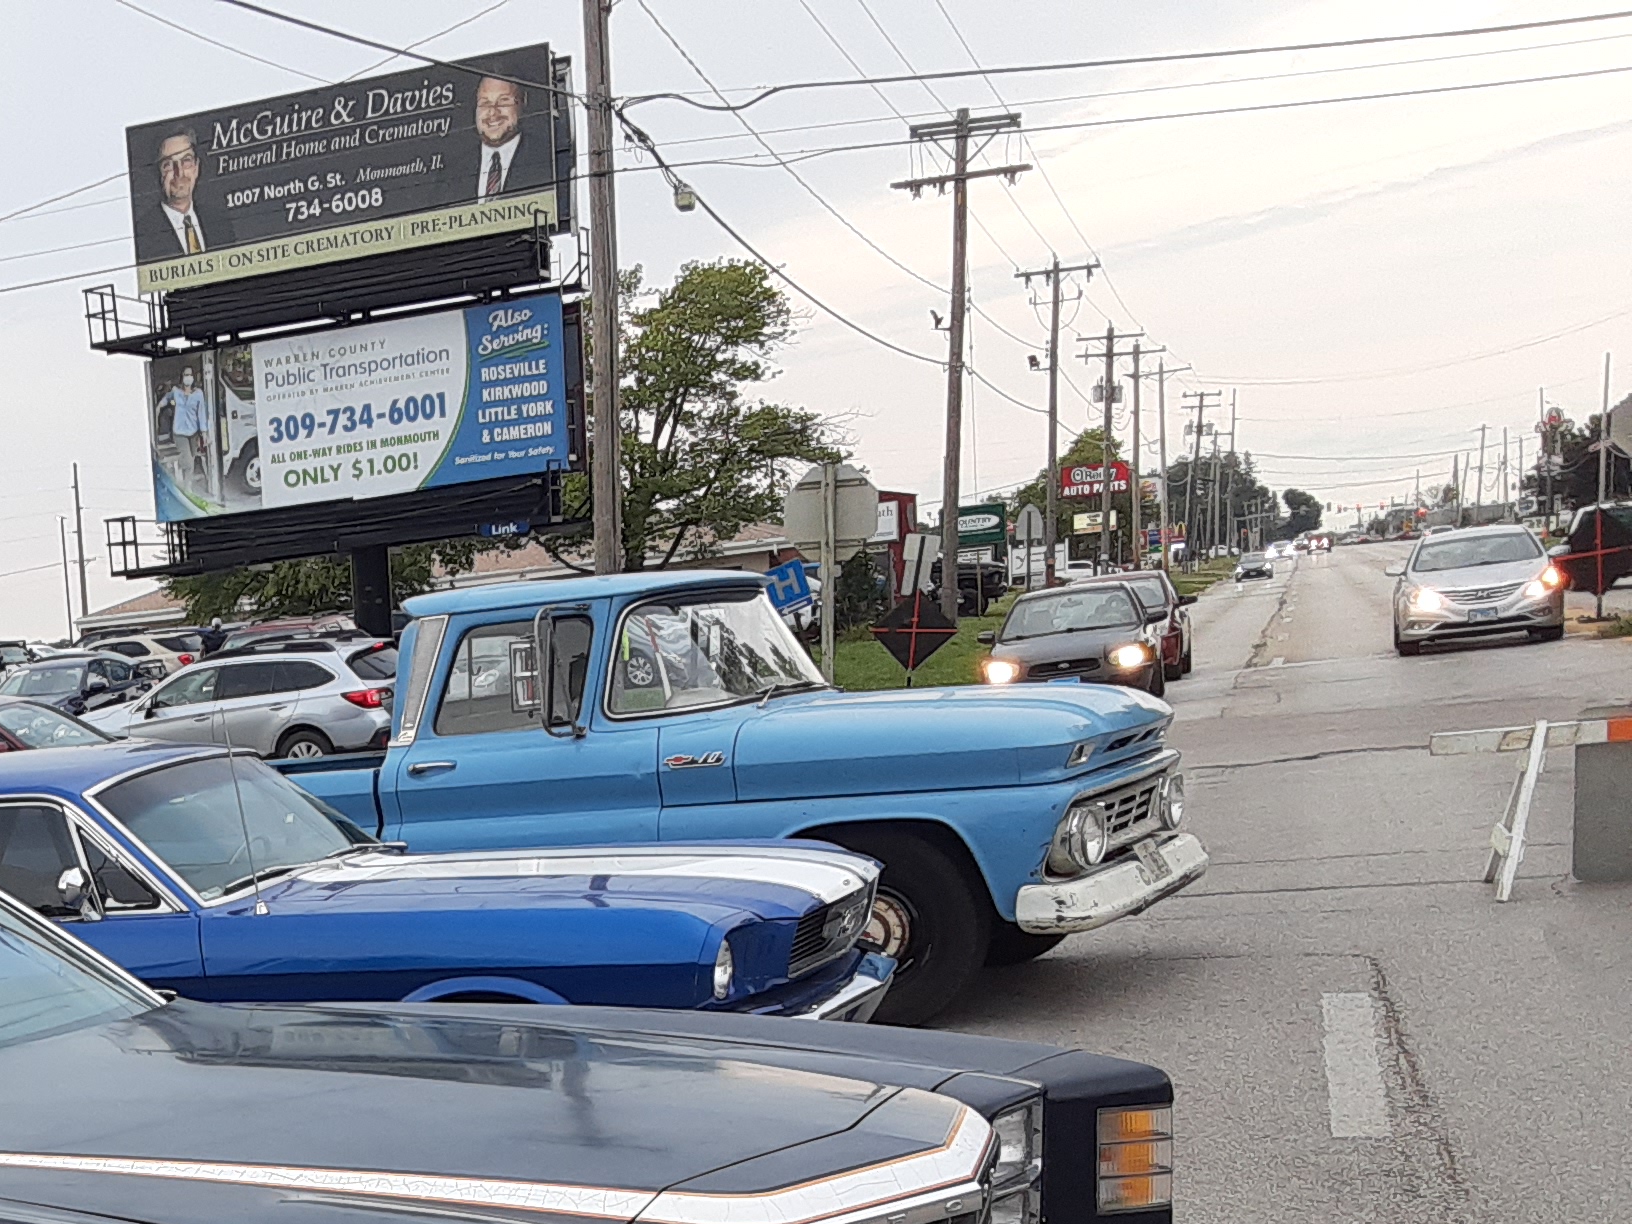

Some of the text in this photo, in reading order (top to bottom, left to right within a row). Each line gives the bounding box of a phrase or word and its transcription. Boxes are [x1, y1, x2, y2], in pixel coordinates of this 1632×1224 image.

[211, 79, 454, 150] McGuire & Davies
[217, 116, 451, 175] Funeral Home and Crematory
[225, 187, 261, 208] 1007
[264, 174, 305, 200] North
[307, 174, 324, 191] G.
[326, 172, 346, 188] St.
[354, 157, 428, 184] Monmouth,
[285, 187, 384, 223] 734-6008
[149, 258, 215, 284] BURIALS
[256, 243, 291, 263] SITE
[293, 225, 395, 257] CREMATORY
[410, 201, 539, 237] PRE-PLANNING
[488, 308, 533, 332] Also
[263, 338, 387, 369] WARREN COUNTY
[478, 323, 549, 355] Serving:
[264, 345, 450, 390] Public Transportation
[480, 358, 547, 383] ROSEVILLE
[482, 380, 548, 403] KIRKWOOD
[268, 391, 447, 444] 309-734-6001
[478, 400, 554, 423] LITTLE YORK
[270, 429, 440, 465] ALL ONE-WAY RIDES IN MONMOUTH
[481, 421, 552, 443] & CAMERON
[283, 451, 419, 488] ONLY $1.00!
[1063, 484, 1090, 497] AUTO
[491, 521, 519, 536] Link
